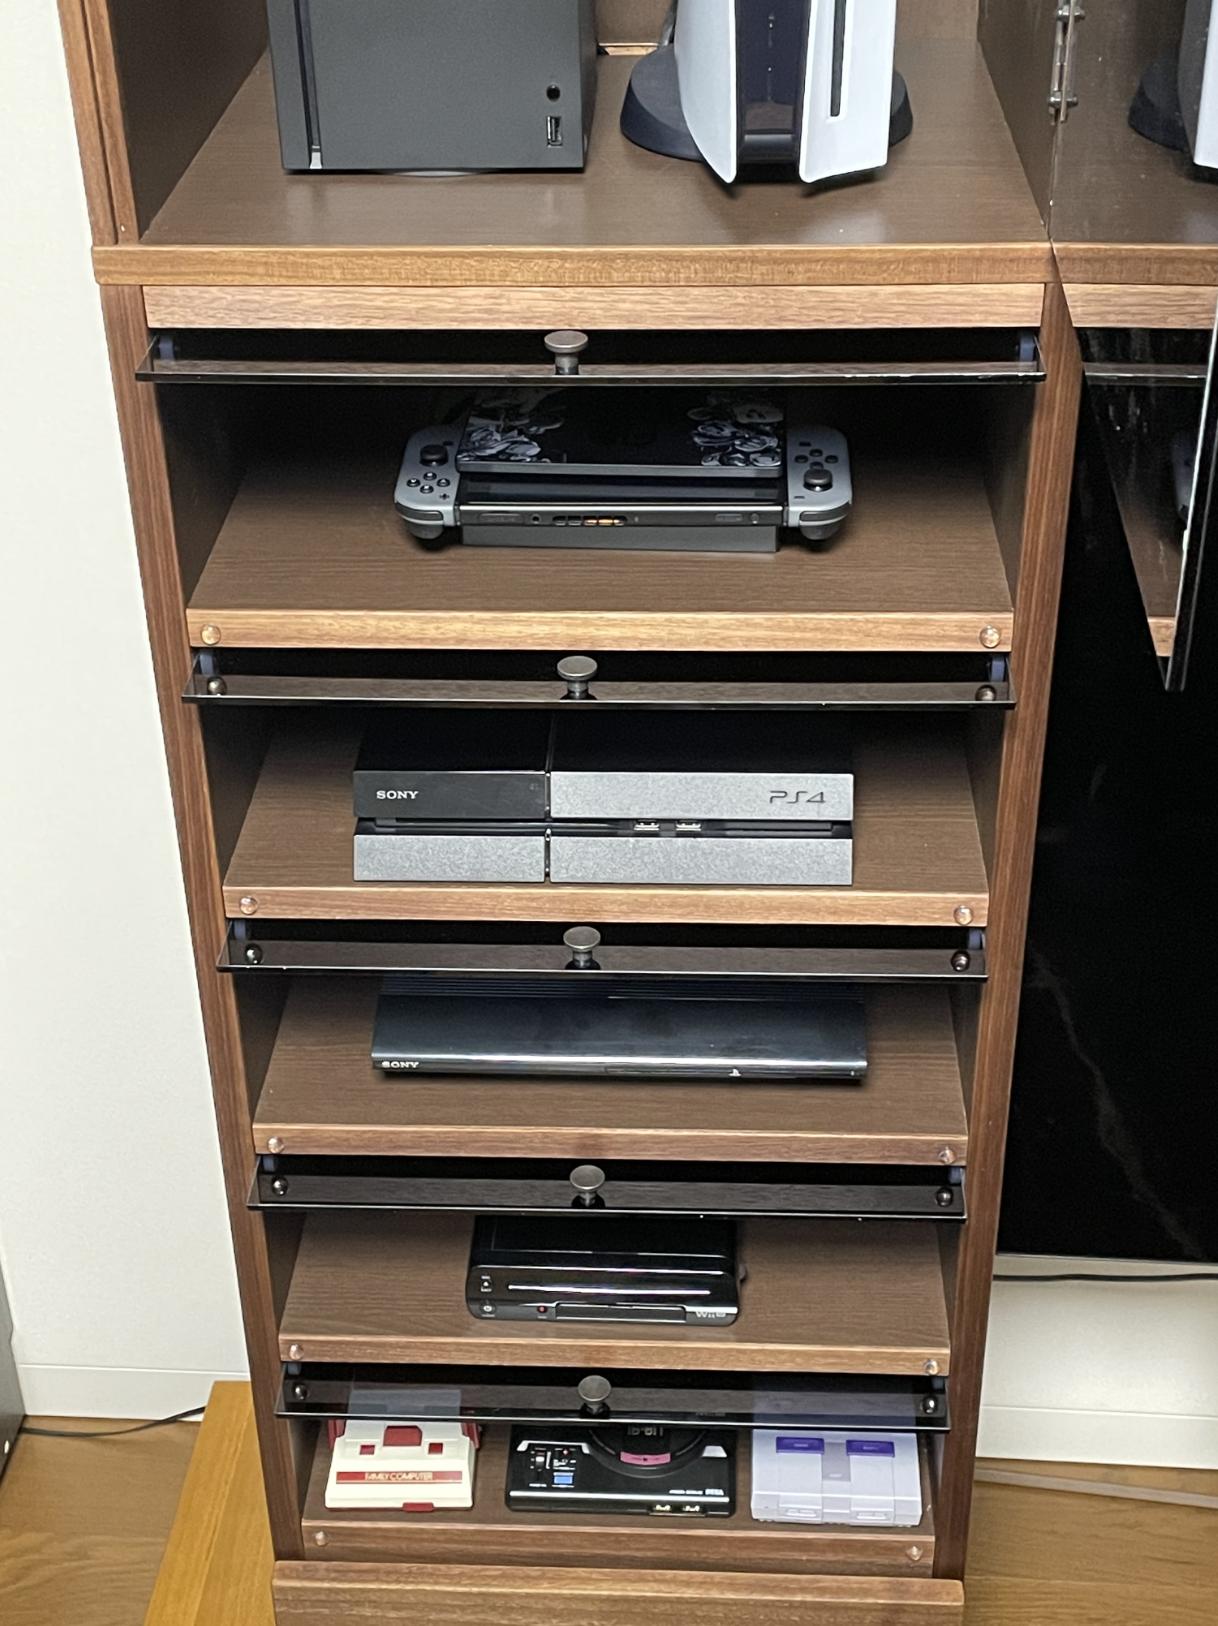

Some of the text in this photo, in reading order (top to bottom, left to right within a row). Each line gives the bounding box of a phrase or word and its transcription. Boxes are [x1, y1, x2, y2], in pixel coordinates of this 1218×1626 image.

[376, 790, 419, 800] SONY
[769, 790, 826, 804] PS4
[381, 1060, 420, 1069] SONY
